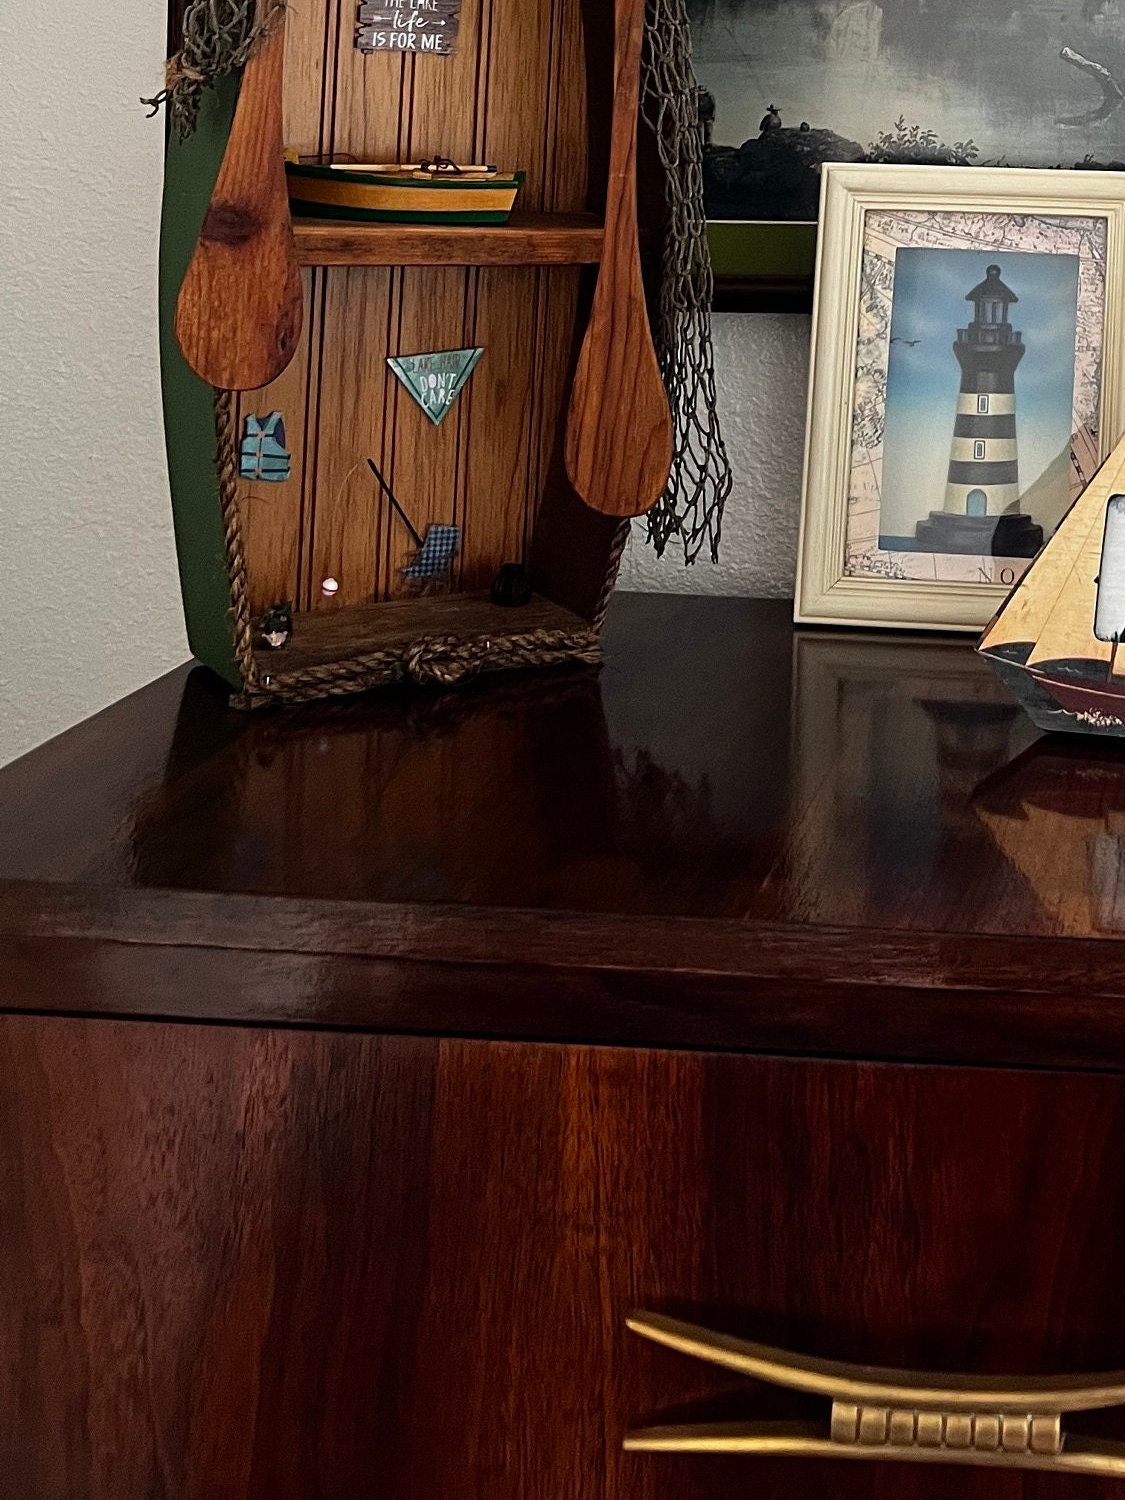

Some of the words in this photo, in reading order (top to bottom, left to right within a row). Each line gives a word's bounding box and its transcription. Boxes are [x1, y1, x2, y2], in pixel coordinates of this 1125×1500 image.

[392, 9, 430, 32] life
[372, 31, 387, 47] IS
[389, 32, 416, 49] FOR
[421, 33, 444, 50] ME
[420, 372, 457, 393] DON'T
[420, 388, 456, 408] CARE
